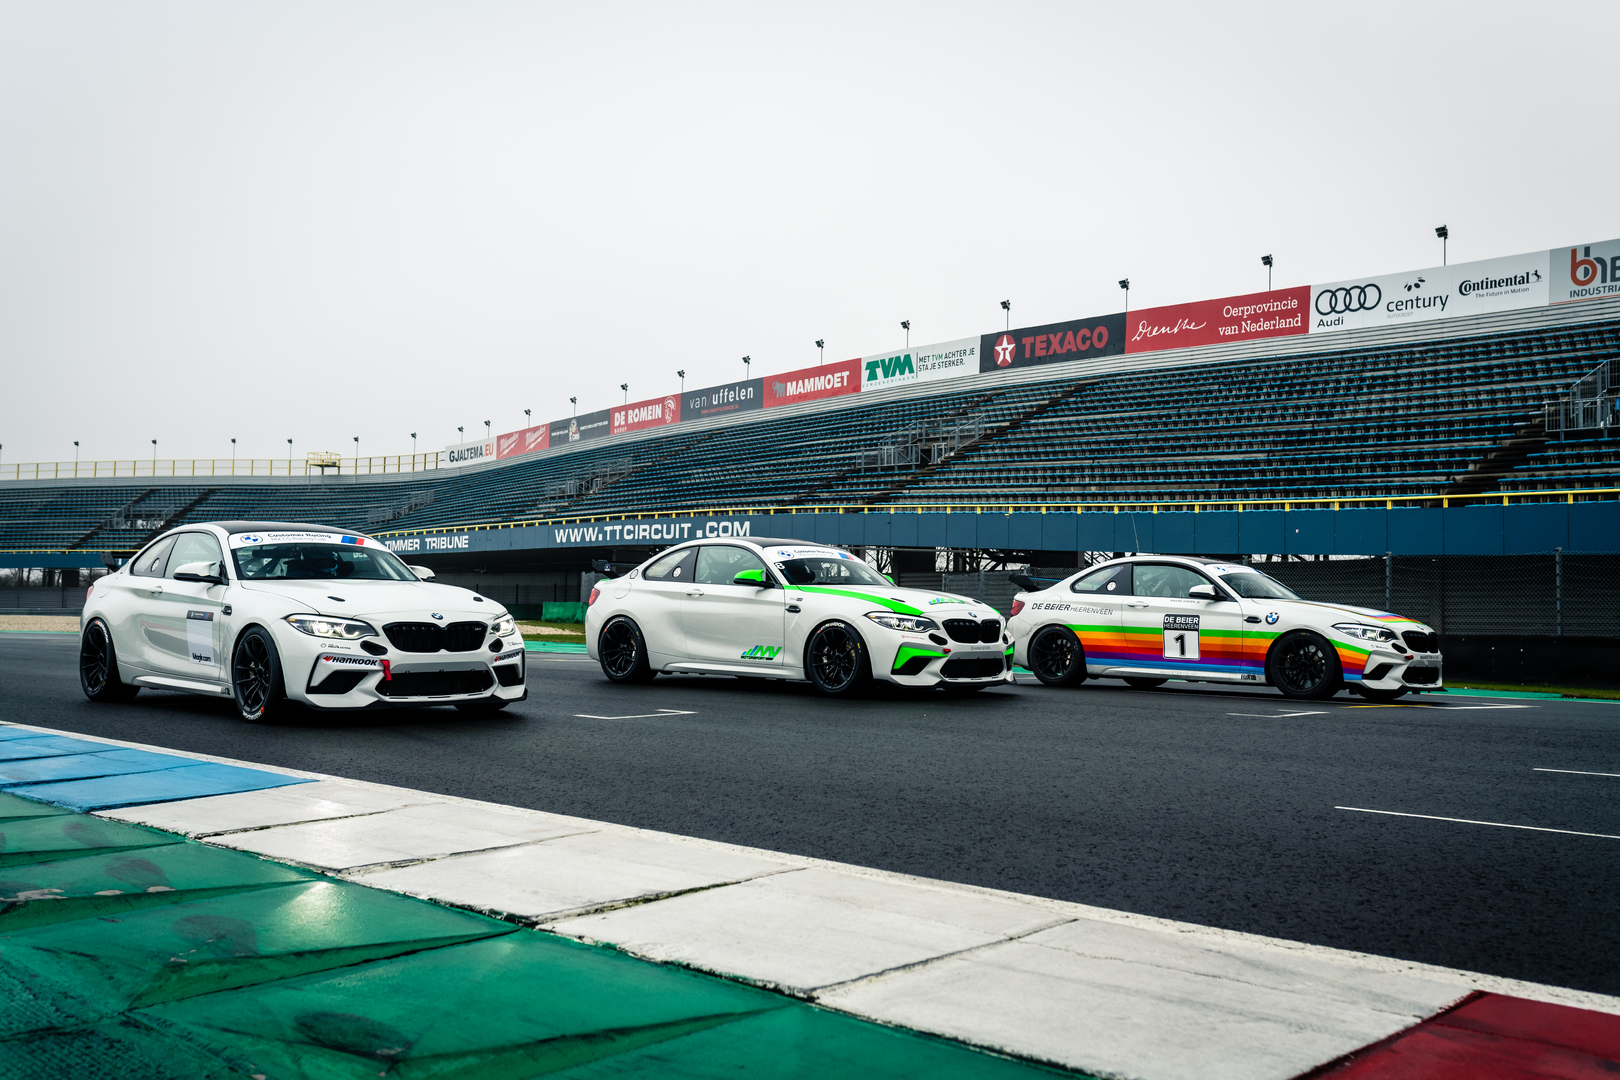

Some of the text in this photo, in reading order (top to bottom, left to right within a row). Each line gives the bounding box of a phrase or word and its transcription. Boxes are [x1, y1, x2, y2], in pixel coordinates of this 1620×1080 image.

[1458, 271, 1530, 296] Continental
[1223, 296, 1298, 318] Oerprovincie
[1386, 294, 1449, 312] century
[1218, 314, 1302, 336] van Nederland
[1316, 316, 1344, 328] Audi
[1386, 311, 1414, 319] AUTOGROEP
[1021, 325, 1109, 358] TEXACO
[918, 347, 975, 363] MET TVM ACHTER JE
[918, 358, 966, 372] STA JE STERKER.
[865, 353, 915, 382] TVM
[786, 371, 850, 396] MAMMOET
[614, 403, 662, 427] DE ROMEIN
[449, 442, 494, 463] GJALTEMA.EU
[384, 535, 469, 552] TIMMER TRIBUNE
[1031, 602, 1114, 615] DE BEIER HEERENVEEN
[1176, 616, 1199, 624] BEIER
[1173, 632, 1187, 657] 1
